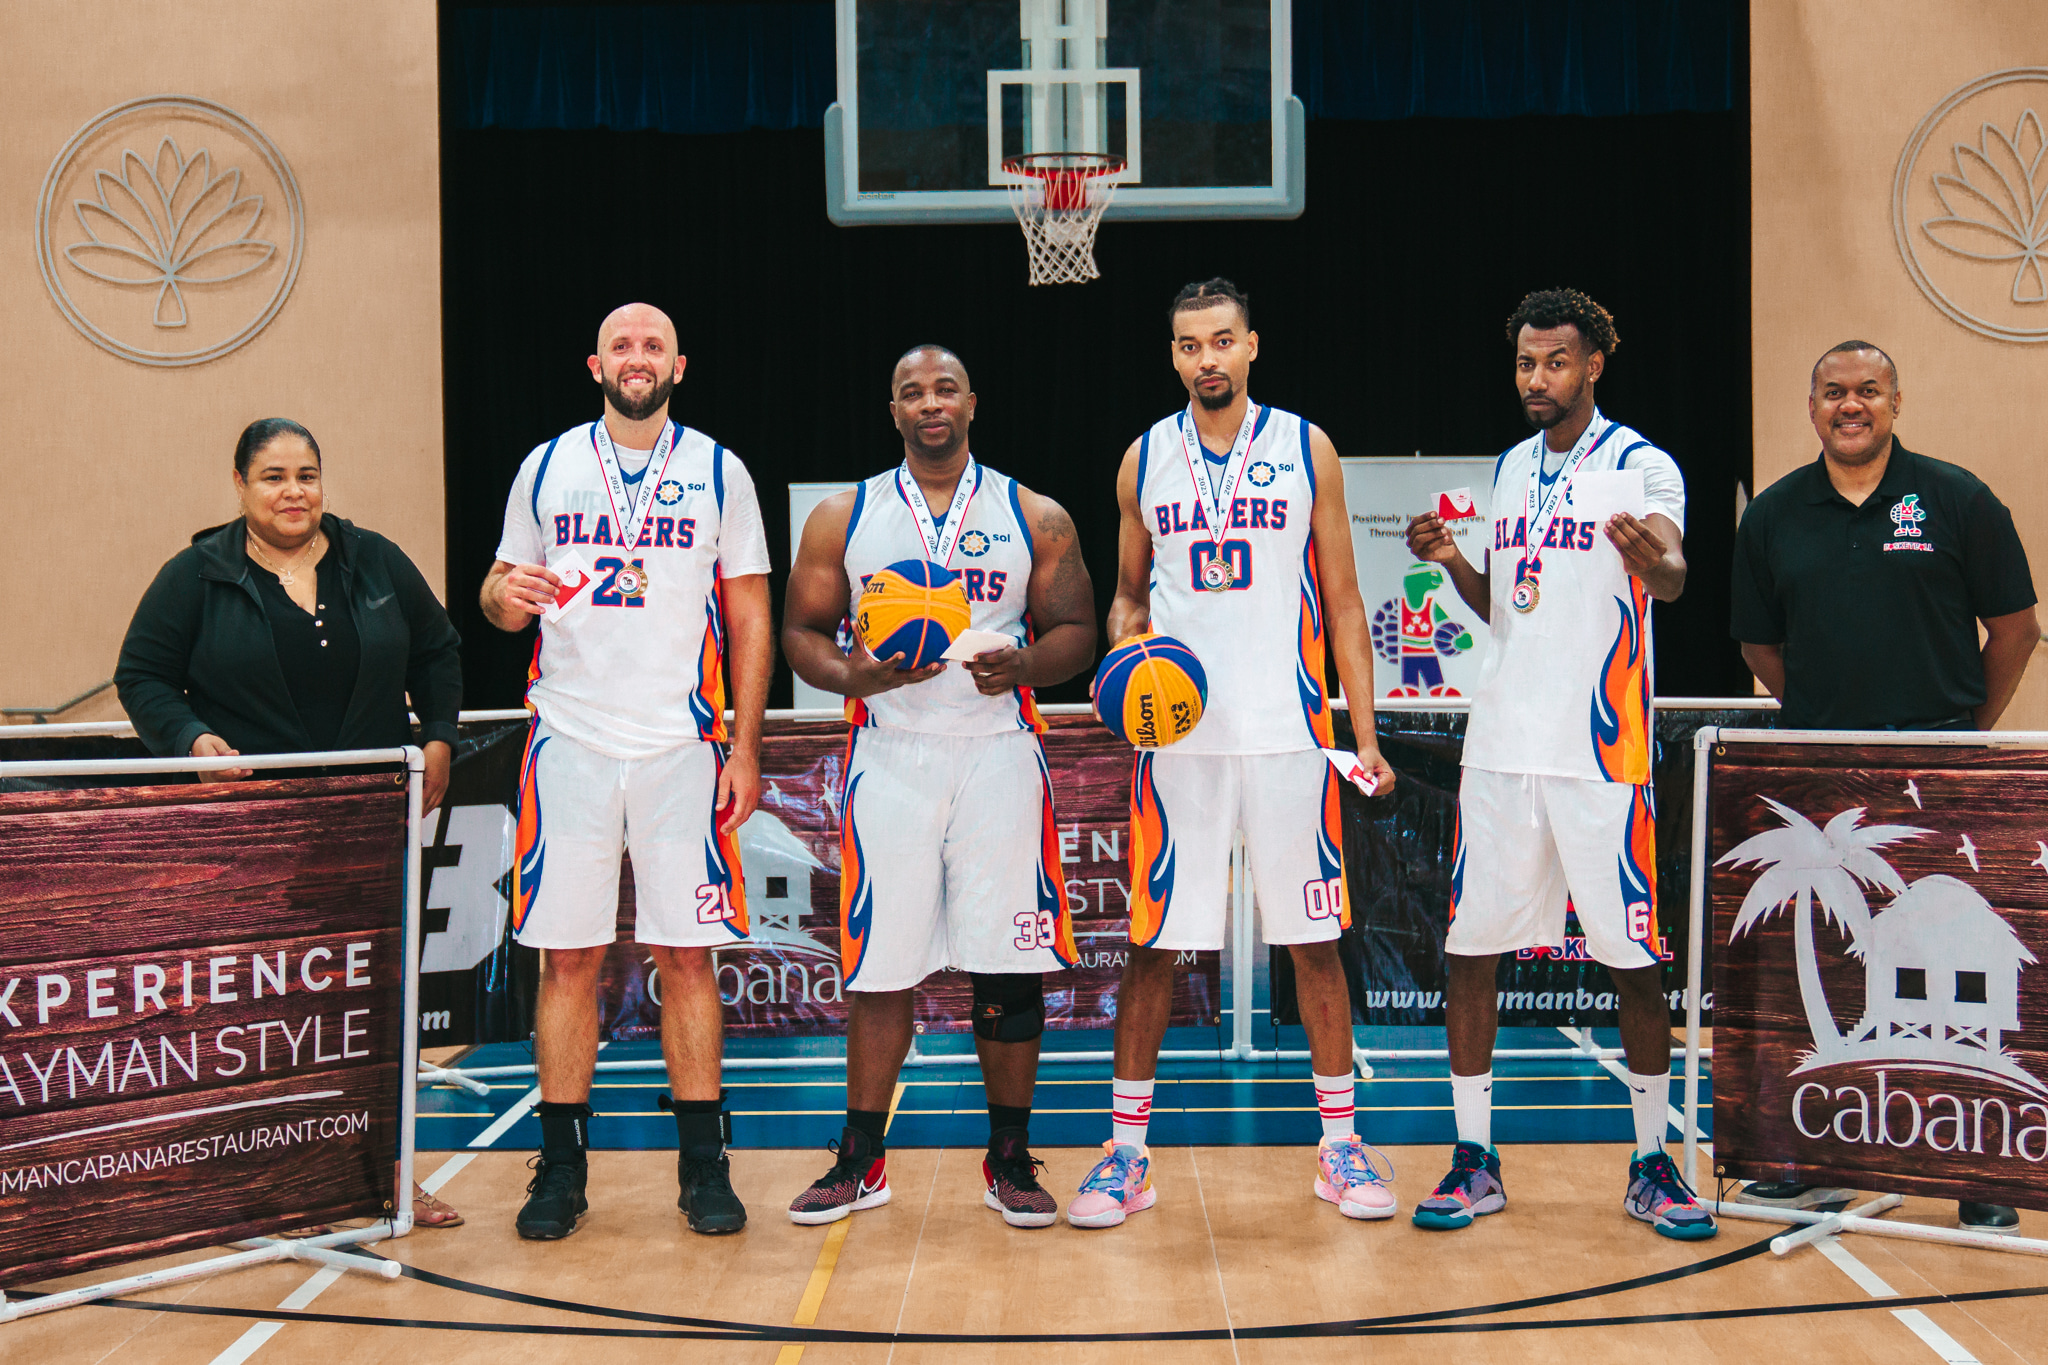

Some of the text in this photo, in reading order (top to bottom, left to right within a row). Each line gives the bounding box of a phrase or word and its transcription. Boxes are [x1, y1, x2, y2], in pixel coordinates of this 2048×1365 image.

[598, 431, 607, 447] 2023
[1185, 428, 1196, 447] 2023
[1242, 421, 1252, 441] 2023
[658, 440, 669, 459] 2023
[1570, 446, 1586, 465] 2023
[610, 475, 621, 495] 2023
[640, 486, 651, 506] 2023
[1197, 477, 1208, 496] 2023
[1223, 474, 1235, 496] 2023
[911, 493, 923, 508] 2023
[954, 493, 966, 511] 2023
[1545, 494, 1559, 516] 2023
[1154, 498, 1288, 537] BLAERS
[1352, 513, 1402, 524] Positively
[554, 513, 696, 550] BLAERS
[1369, 528, 1407, 538] Throug
[1494, 516, 1596, 552] BLAERS
[1188, 538, 1253, 593] 00
[695, 881, 737, 924] 21
[1303, 876, 1343, 921] 00
[1014, 909, 1056, 950] 33
[1627, 900, 1650, 943] 6
[646, 950, 844, 1007] bana
[215, 1008, 371, 1076] STYLE
[1792, 1070, 2048, 1162] cabana
